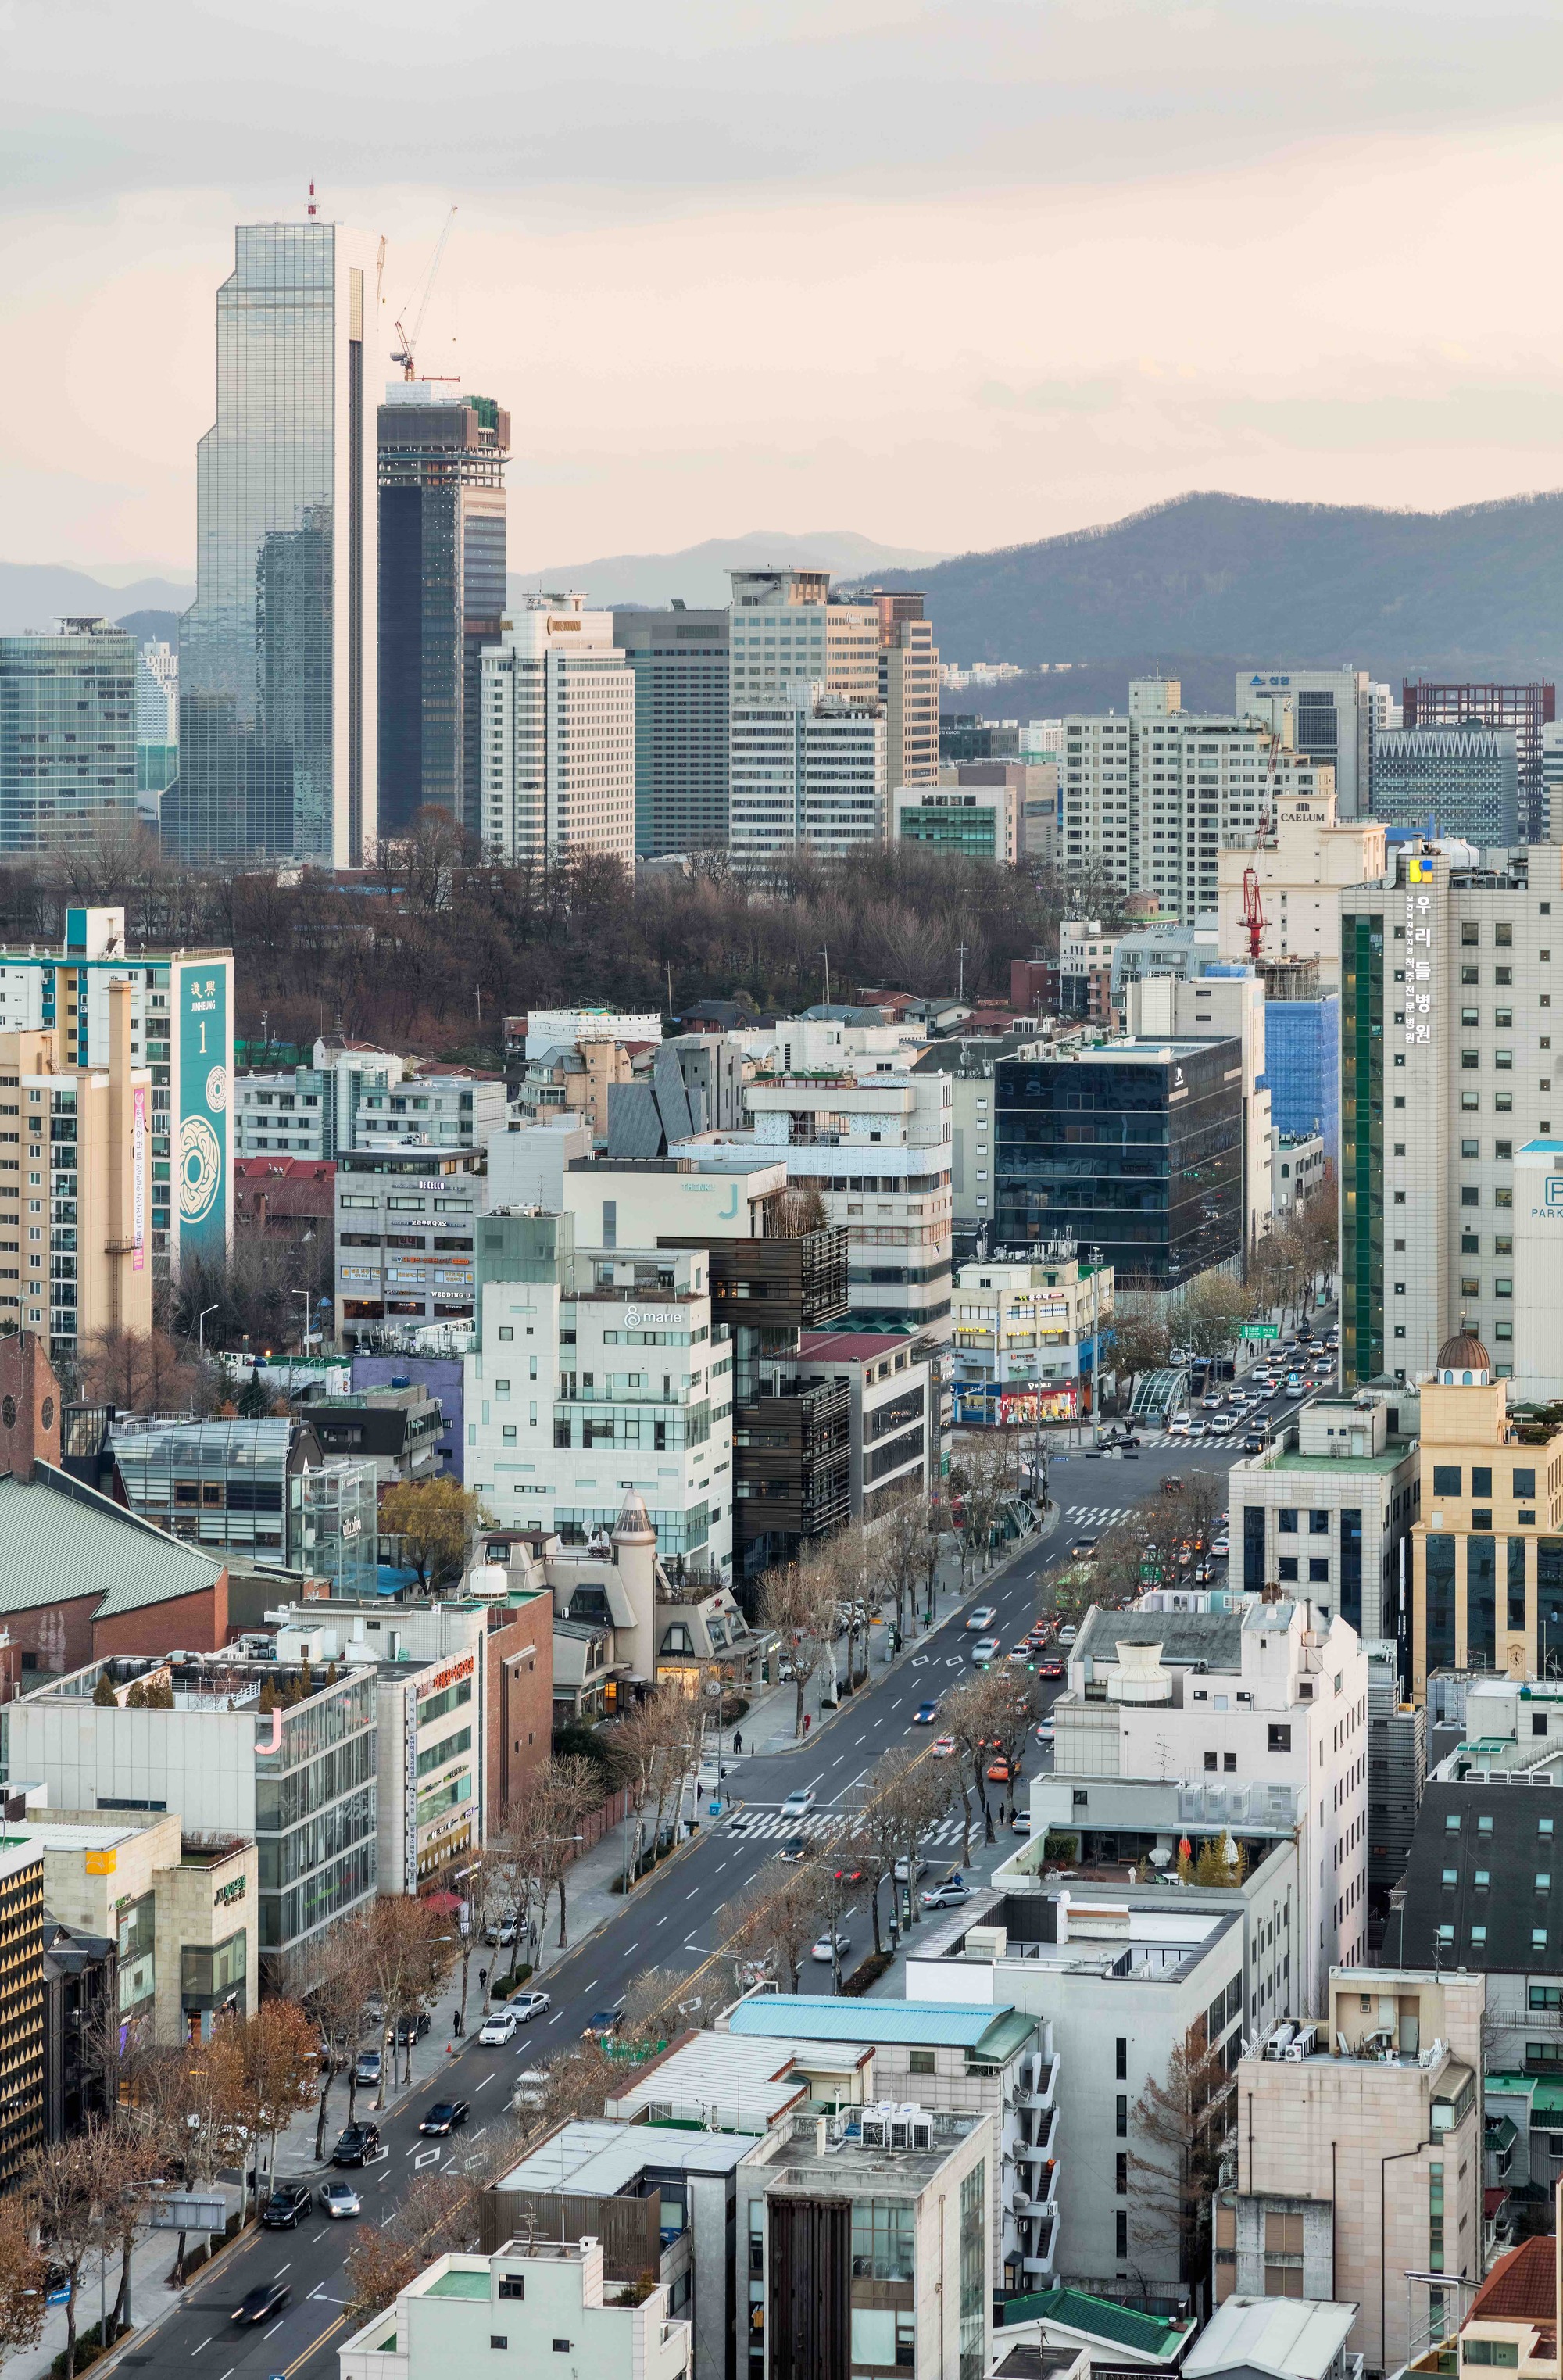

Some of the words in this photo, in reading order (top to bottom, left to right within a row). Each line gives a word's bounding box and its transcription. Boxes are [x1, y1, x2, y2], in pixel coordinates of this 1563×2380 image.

[1281, 813, 1325, 821] CAELUM
[1415, 896, 1432, 1044] 우리들병원
[191, 1000, 216, 1012] JINHEUNG
[199, 1020, 207, 1054] 1
[419, 1180, 427, 1189] DE
[427, 1181, 445, 1190] CECCO
[643, 1313, 682, 1323] marie
